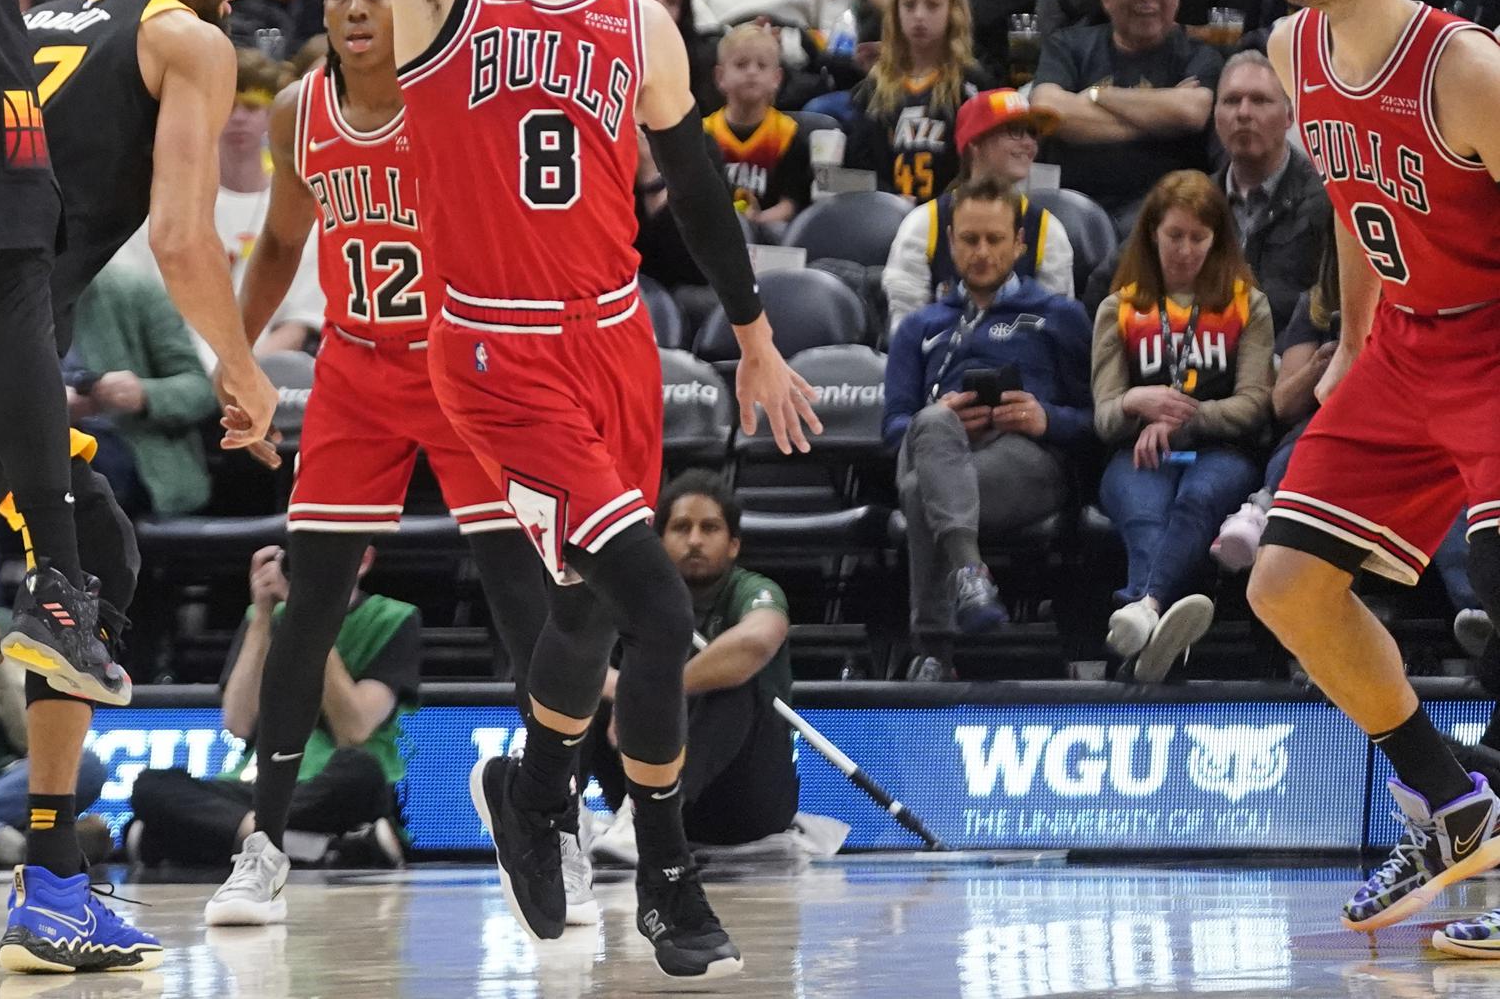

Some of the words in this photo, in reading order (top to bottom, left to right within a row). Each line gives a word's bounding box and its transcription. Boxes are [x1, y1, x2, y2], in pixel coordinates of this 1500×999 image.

[468, 26, 633, 143] BULLS
[519, 109, 581, 210] 8
[724, 162, 768, 197] TAH
[894, 152, 935, 198] 45
[1303, 120, 1431, 215] BULLS
[307, 165, 424, 235] BULL
[1351, 202, 1411, 285] 9
[342, 238, 427, 323] 12
[662, 380, 719, 404] rata
[955, 725, 1176, 797] WGU
[963, 808, 1011, 837] THE
[1017, 808, 1161, 837] UNIVERSITY
[1167, 808, 1206, 837] OF
[1213, 808, 1272, 837] YOU
